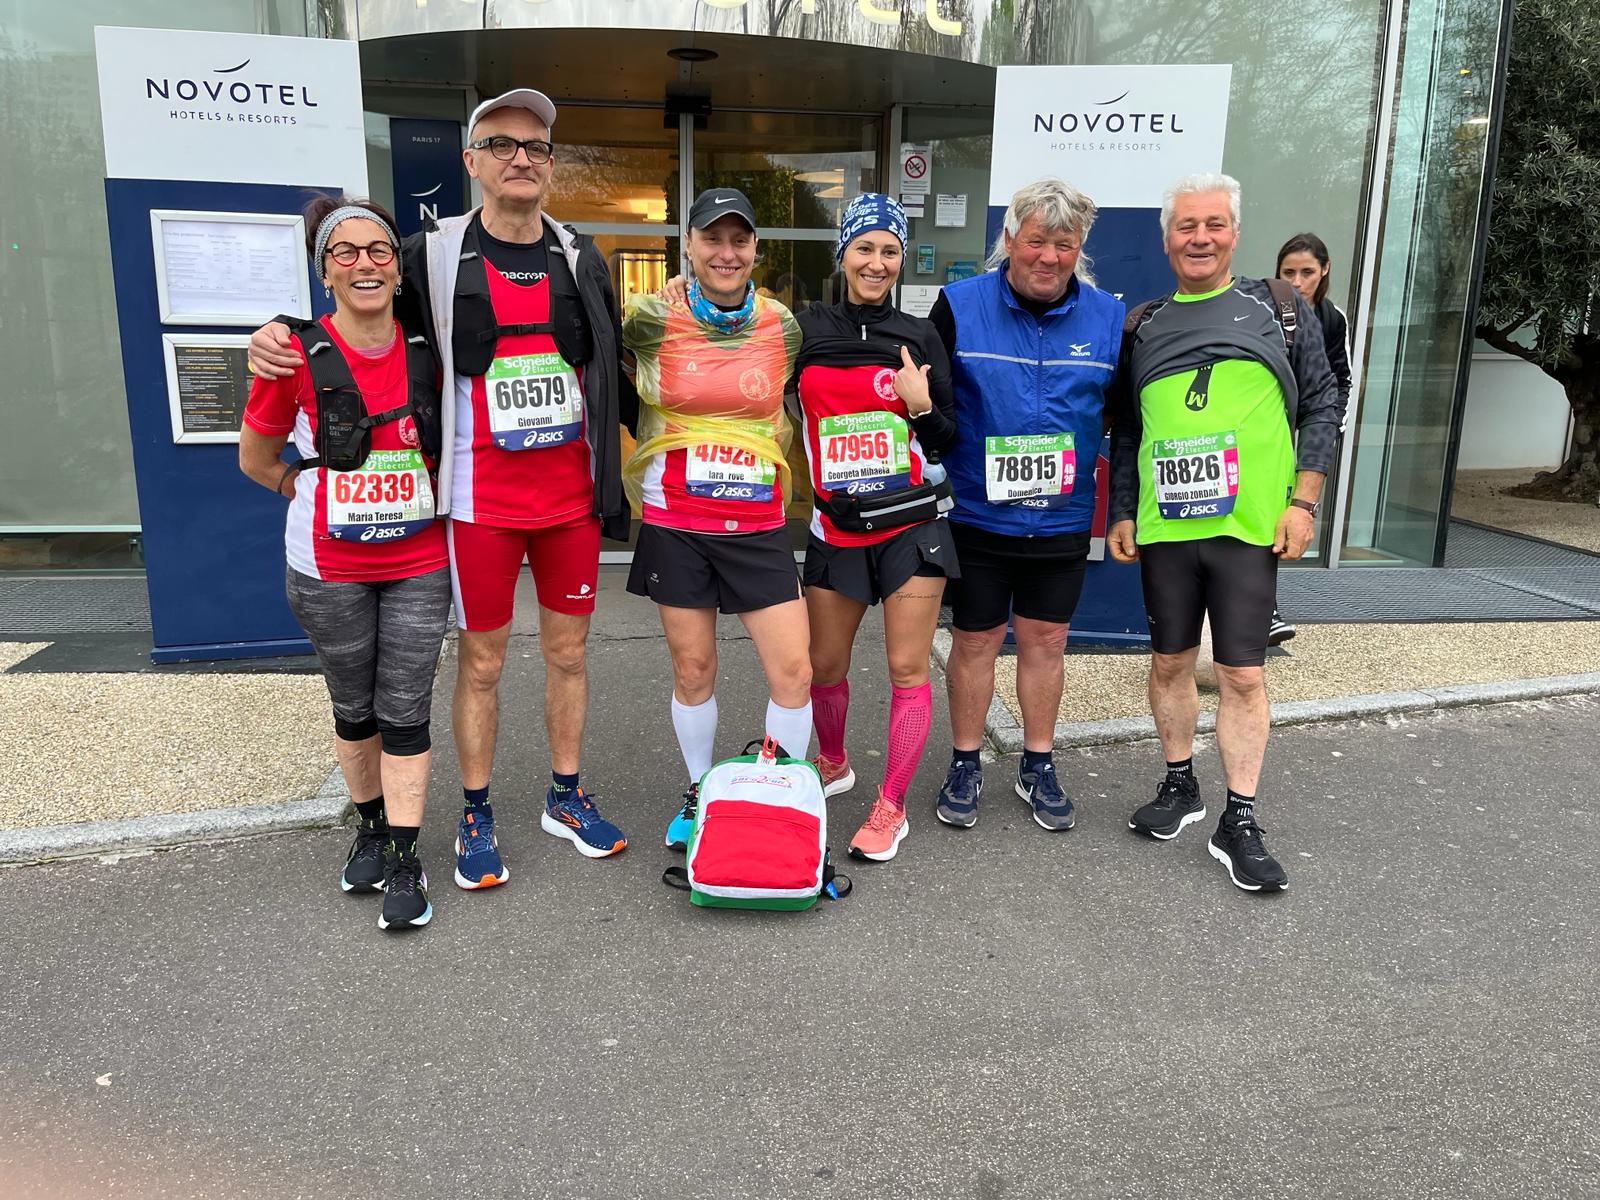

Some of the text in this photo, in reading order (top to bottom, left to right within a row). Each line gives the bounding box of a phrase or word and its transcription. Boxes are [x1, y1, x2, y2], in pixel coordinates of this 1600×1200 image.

[146, 78, 318, 107] NOVOTEL
[170, 110, 297, 125] HOTELS & RESORTS
[1033, 113, 1184, 133] NOVOTEL
[1050, 142, 1161, 151] HOTELS & RESORTS
[503, 354, 560, 369] Schneider
[531, 365, 562, 374] Electric
[495, 375, 566, 411] 66579
[517, 414, 553, 427] Giovanni
[833, 412, 887, 427] Schneider
[855, 421, 887, 431] Electric
[827, 431, 889, 464] 47956
[1004, 435, 1059, 447] Schneider
[1163, 435, 1218, 450] Schneider
[1185, 444, 1218, 454] Electric
[828, 466, 890, 481] Georgeta Mihaela
[995, 454, 1057, 482] 78815
[1064, 463, 1075, 474] 4h
[1156, 454, 1220, 486] 78826
[1227, 462, 1238, 473] 4h
[1063, 475, 1074, 485] 30
[1228, 474, 1238, 486] 30
[334, 472, 414, 504] 62339
[1007, 487, 1042, 498] Domenico
[1164, 488, 1219, 501] GIORGIO ZORDAN
[422, 497, 431, 509] 15
[348, 511, 403, 522] Maria Teresa
